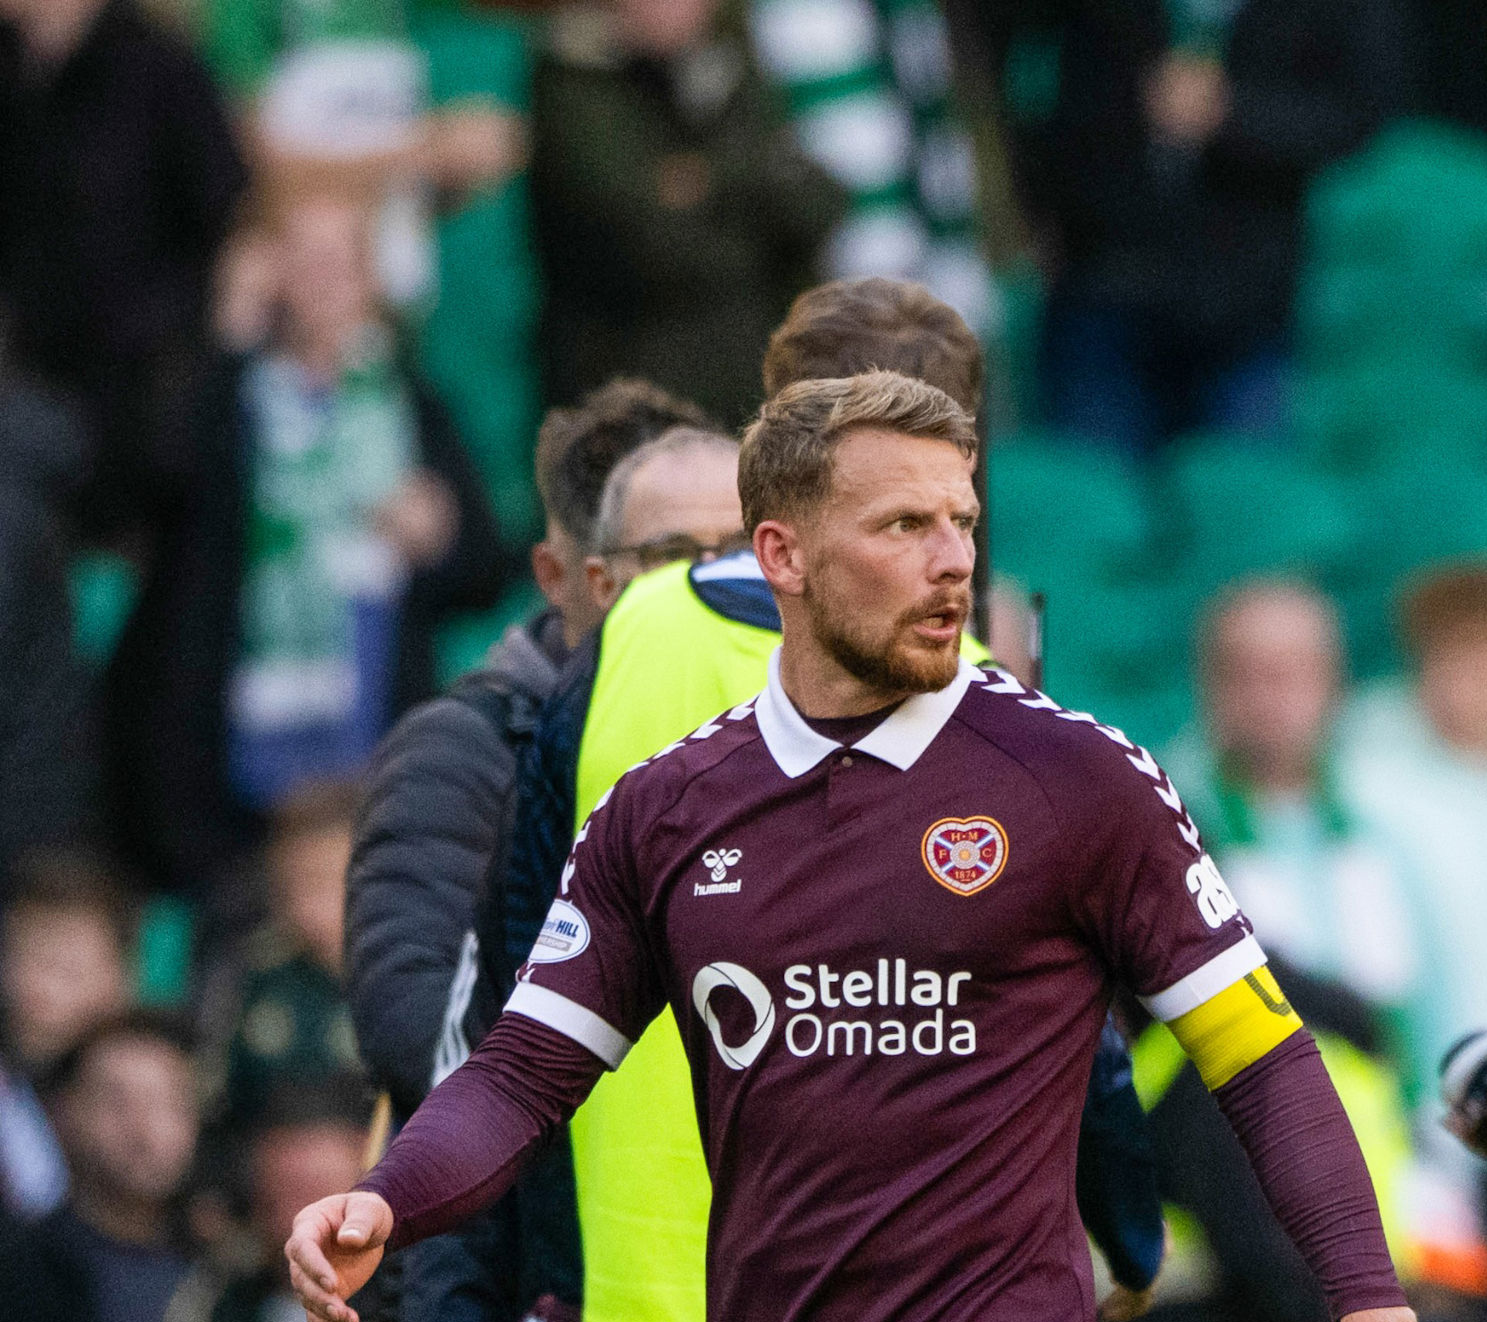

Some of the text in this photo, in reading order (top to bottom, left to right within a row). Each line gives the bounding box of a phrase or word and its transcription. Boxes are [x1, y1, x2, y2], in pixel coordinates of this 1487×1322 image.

[939, 848, 992, 859] F C
[955, 871, 976, 880] 1874
[694, 879, 742, 896] hummel
[556, 920, 579, 938] HILL
[784, 958, 972, 1010] Stellar
[785, 1008, 977, 1057] Omada
